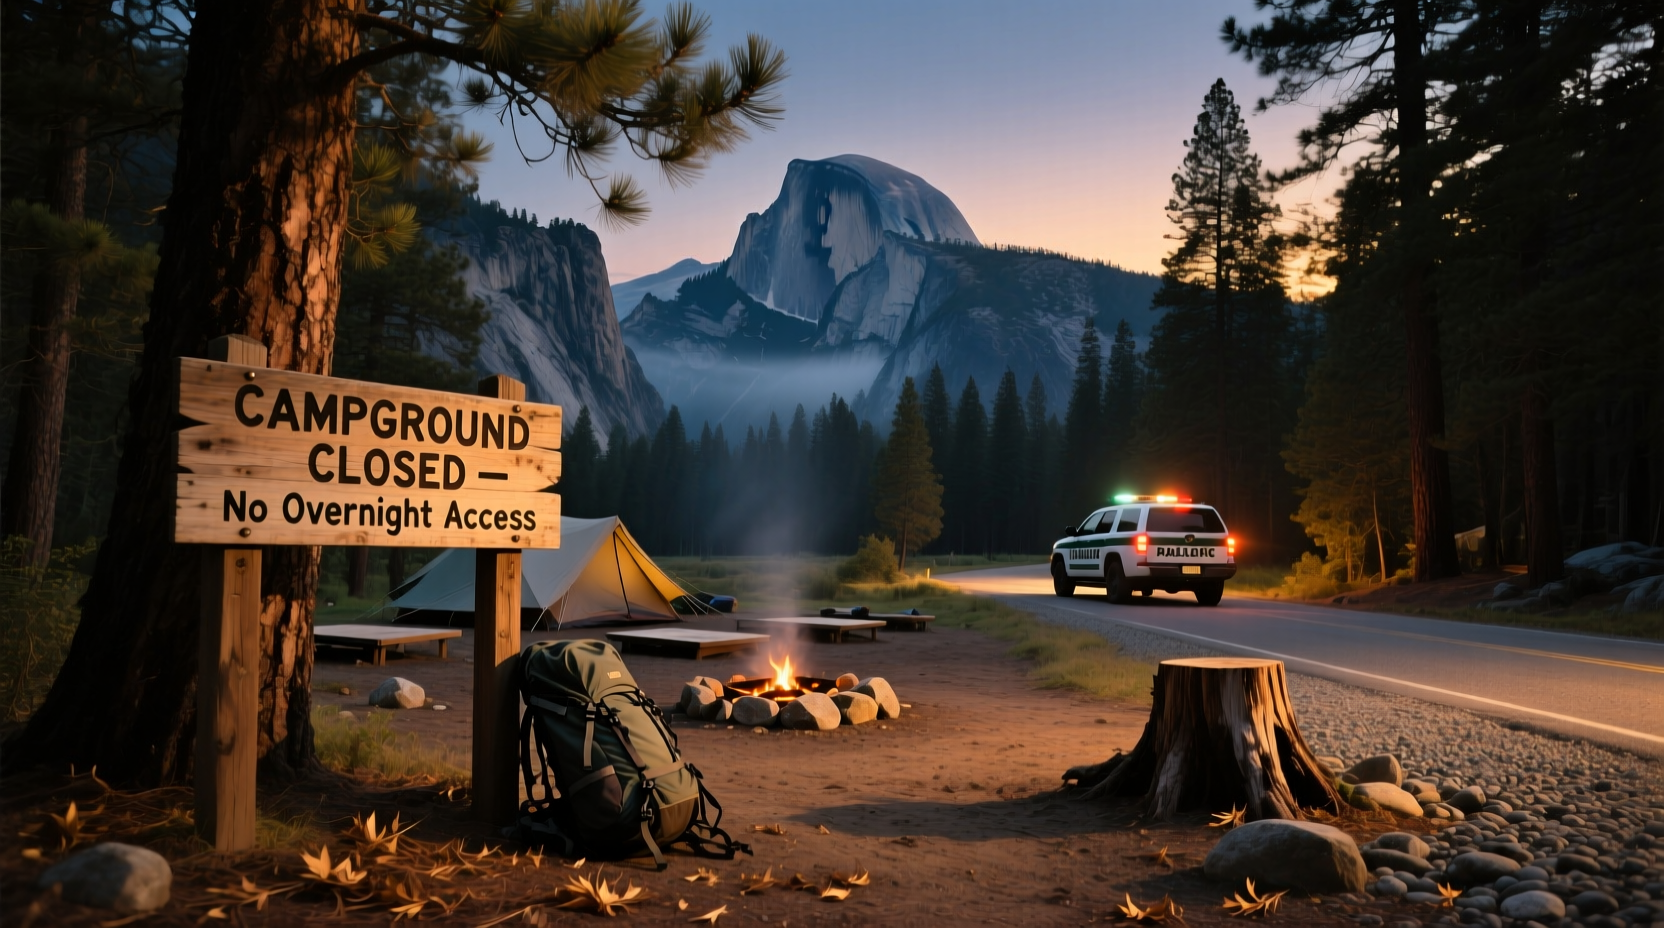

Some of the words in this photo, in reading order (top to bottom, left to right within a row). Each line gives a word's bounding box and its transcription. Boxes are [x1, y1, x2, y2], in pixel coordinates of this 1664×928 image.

[234, 383, 530, 451] CAMPGROUND
[308, 443, 466, 490] CLOSED
[223, 489, 268, 523] No
[282, 492, 432, 536] Overnight
[443, 500, 537, 531] Access
